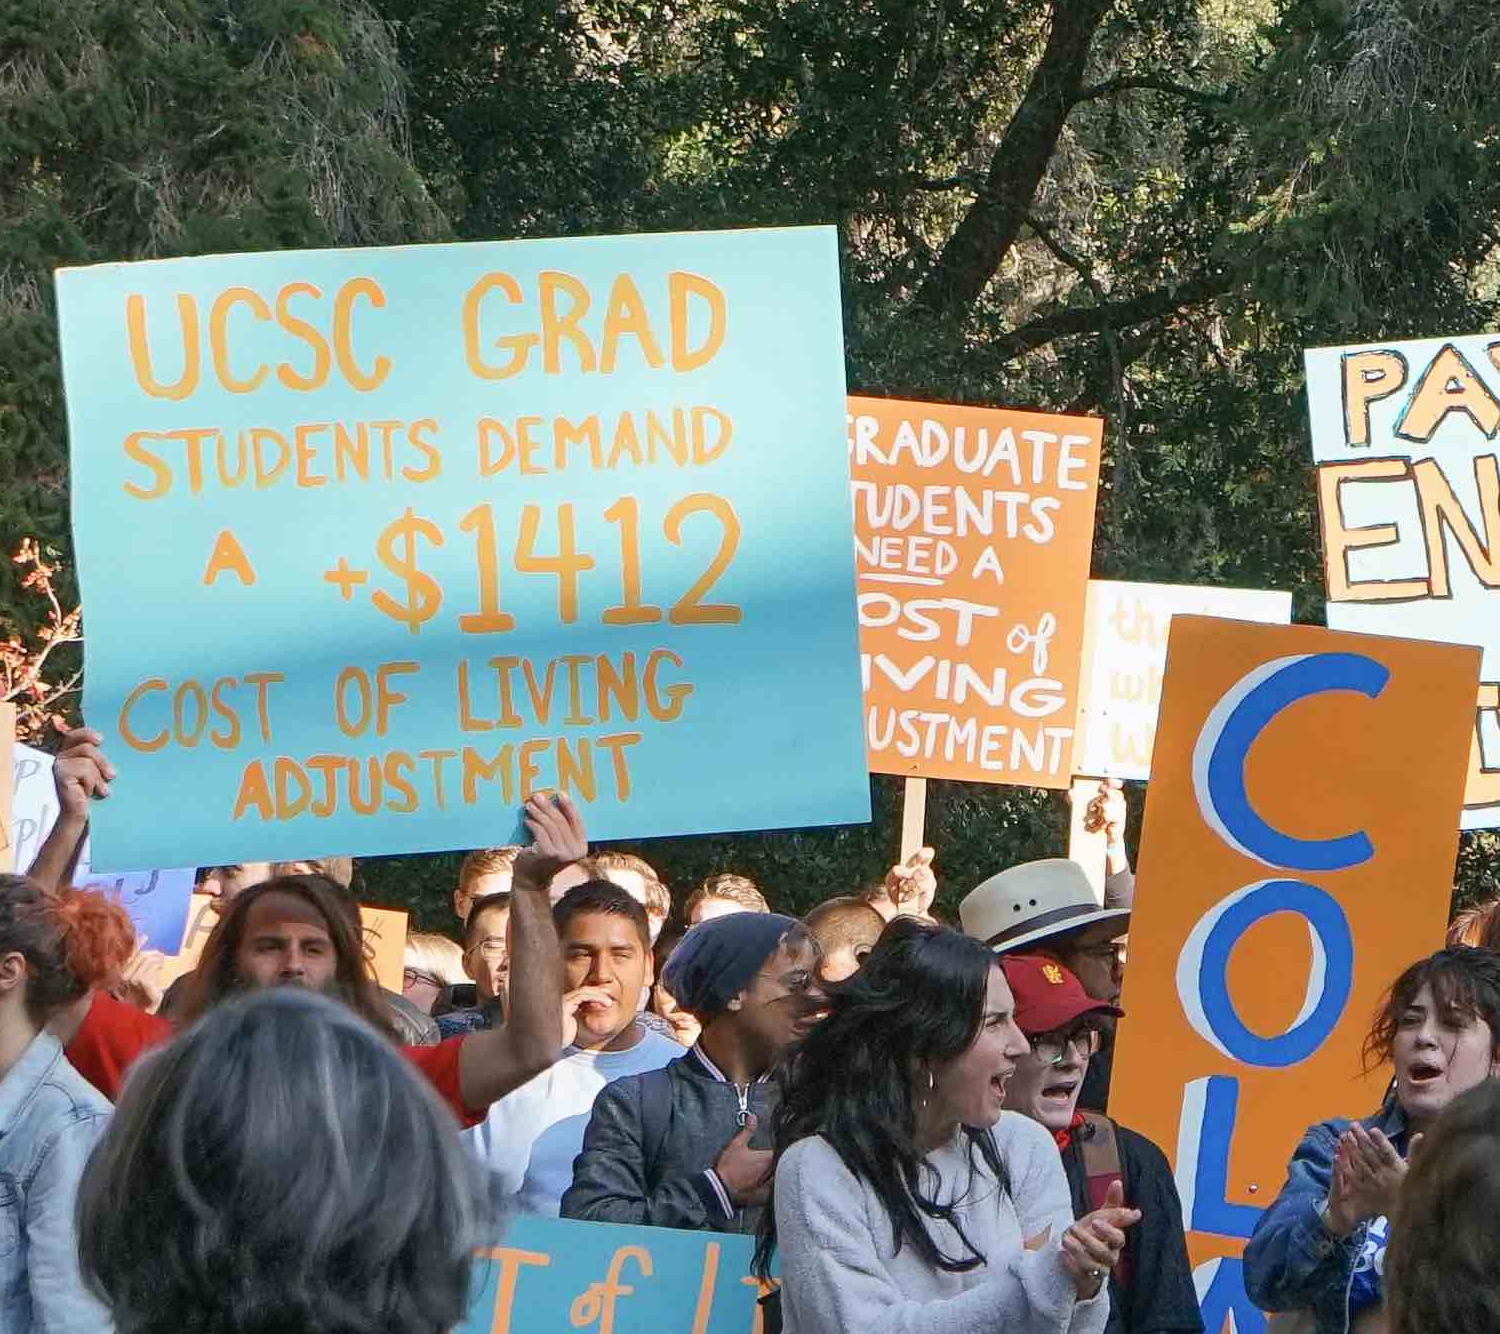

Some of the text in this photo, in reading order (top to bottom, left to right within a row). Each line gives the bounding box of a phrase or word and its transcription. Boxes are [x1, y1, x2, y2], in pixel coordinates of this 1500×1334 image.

[125, 271, 728, 401] UCSC GRAD
[122, 406, 734, 500] STUDENTS DEMAND
[850, 479, 1060, 544] TUDENTS
[203, 492, 743, 636] A +$1412
[853, 534, 1004, 584] NEED A
[858, 592, 1057, 675] OST of
[117, 648, 695, 753] COST OF LIVING
[861, 652, 1068, 717] IVING
[232, 731, 643, 821] ADJUSTMENT
[867, 709, 1075, 775] USTMENT
